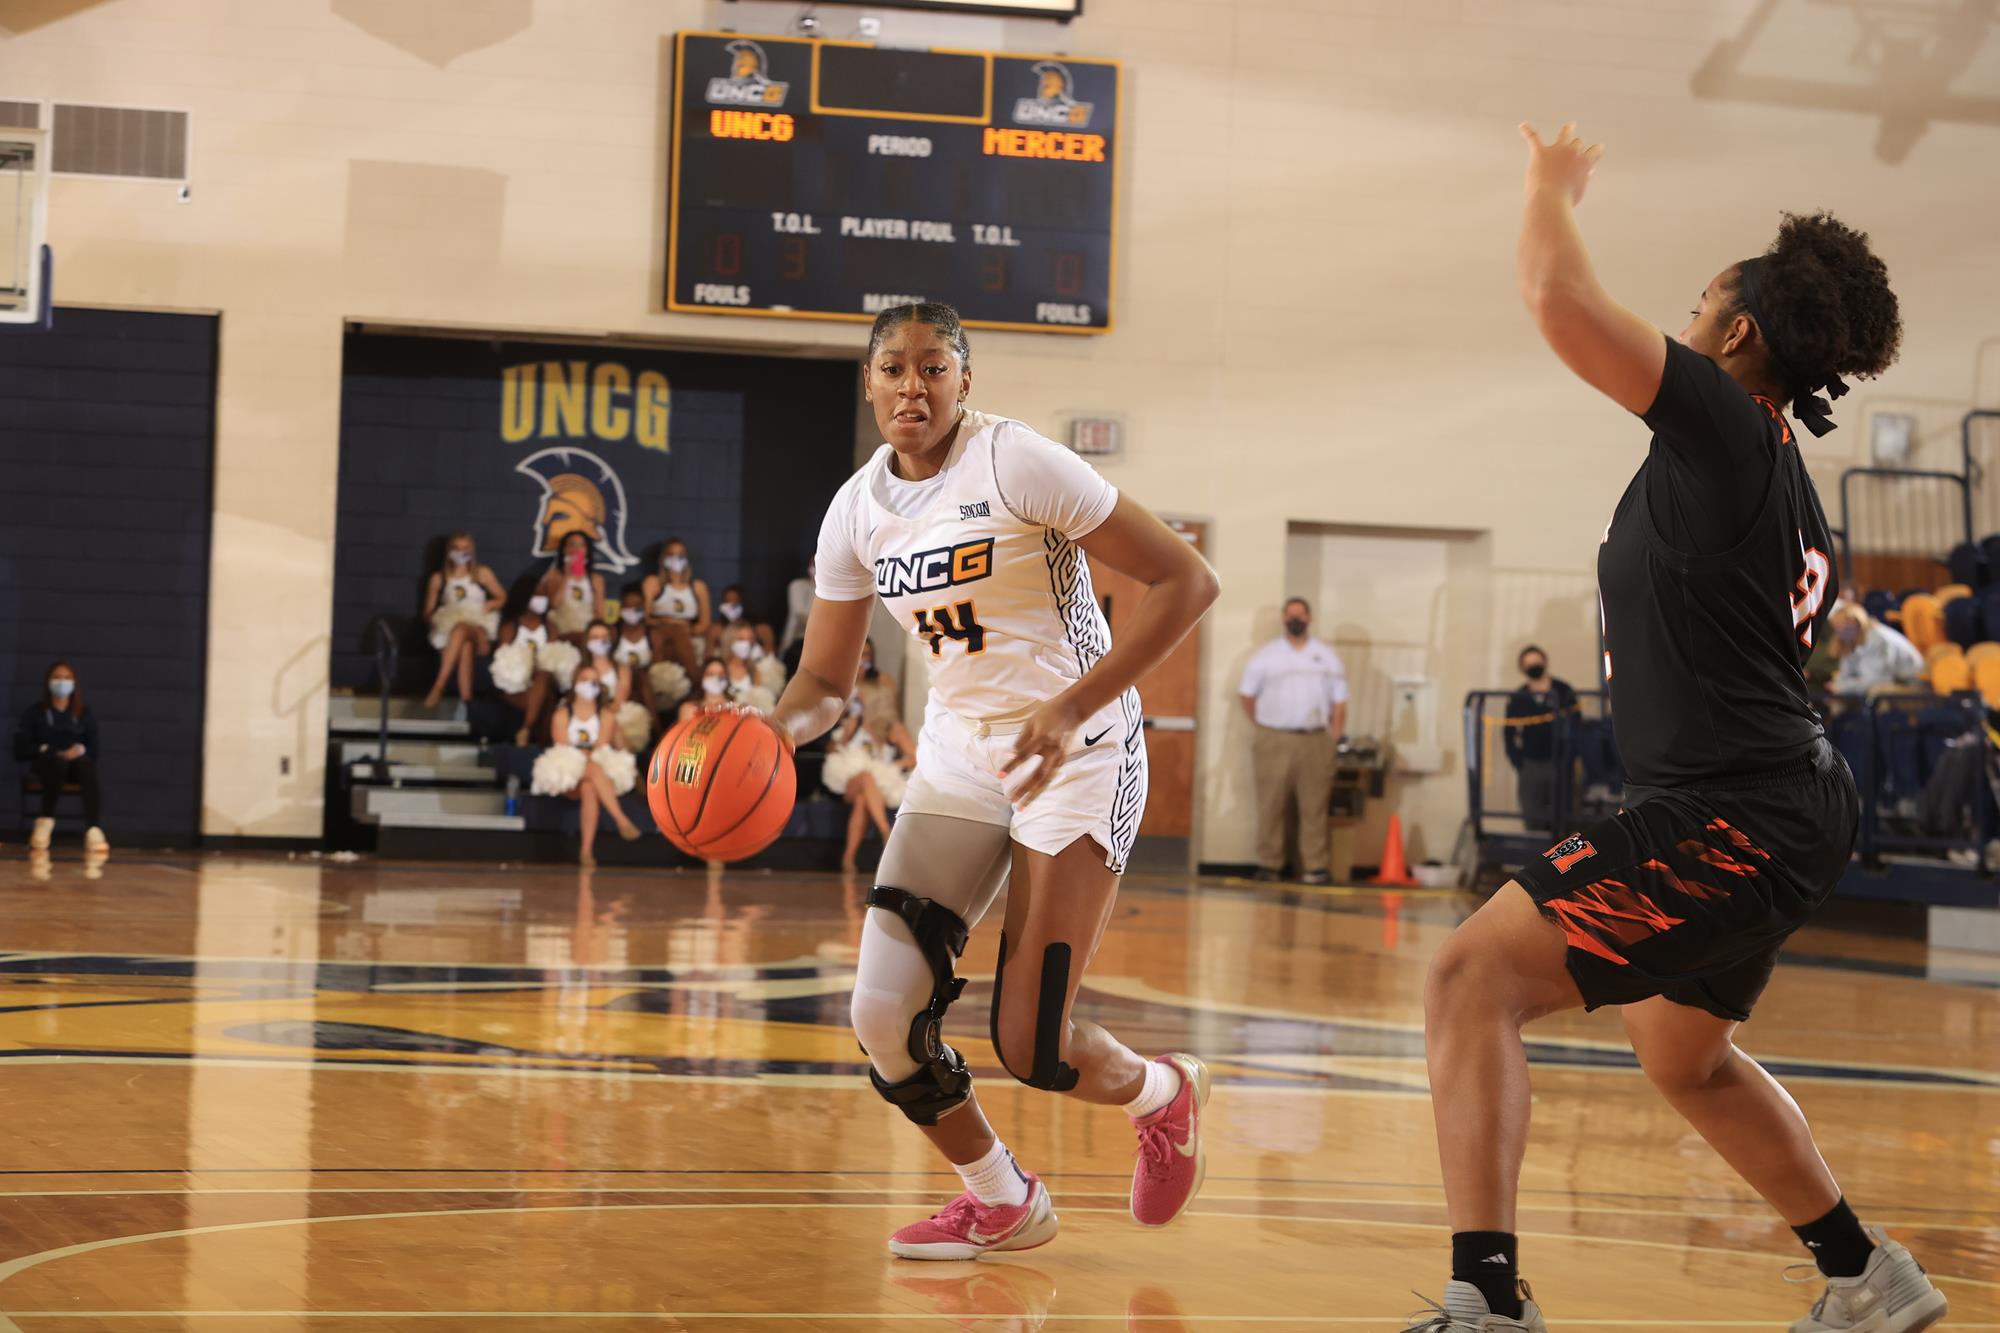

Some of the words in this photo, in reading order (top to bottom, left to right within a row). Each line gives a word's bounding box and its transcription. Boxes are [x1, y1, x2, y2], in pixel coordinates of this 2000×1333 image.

[710, 110, 794, 141] UNCG
[868, 134, 932, 158] PERIOD
[983, 127, 1105, 162] MERCER
[771, 212, 821, 234] T.O.L.
[841, 216, 908, 240] PLAYER
[911, 221, 956, 242] FOUL
[971, 223, 1020, 246] T.O.L.
[694, 283, 751, 305] FOULS
[1036, 302, 1091, 325] FOULS
[502, 361, 671, 454] UNCG
[875, 537, 995, 598] UNCG
